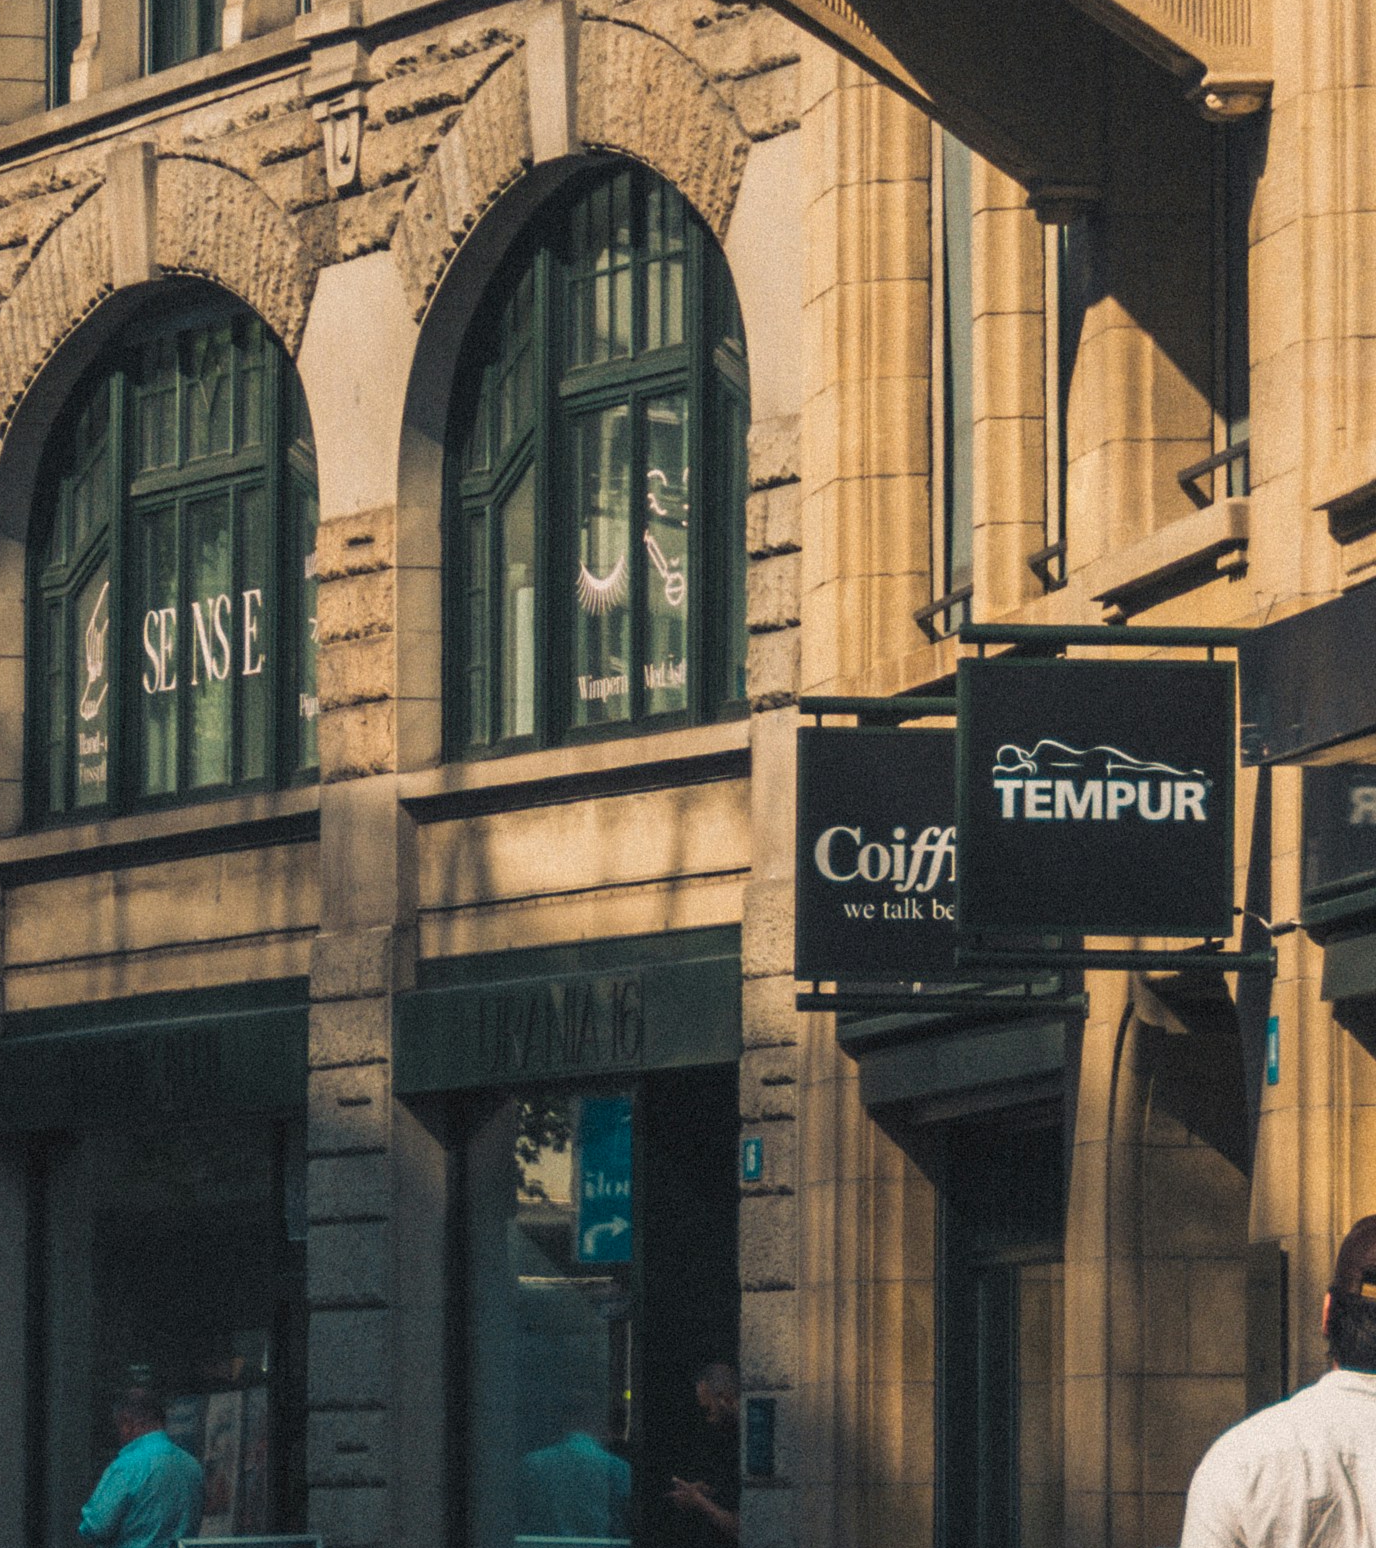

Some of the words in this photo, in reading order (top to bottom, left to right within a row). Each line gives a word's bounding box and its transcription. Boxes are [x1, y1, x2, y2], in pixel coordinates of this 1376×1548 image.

[142, 588, 265, 694] SENSE
[992, 779, 1208, 822] TEMPUR
[843, 903, 876, 920] we
[882, 899, 925, 921] talk
